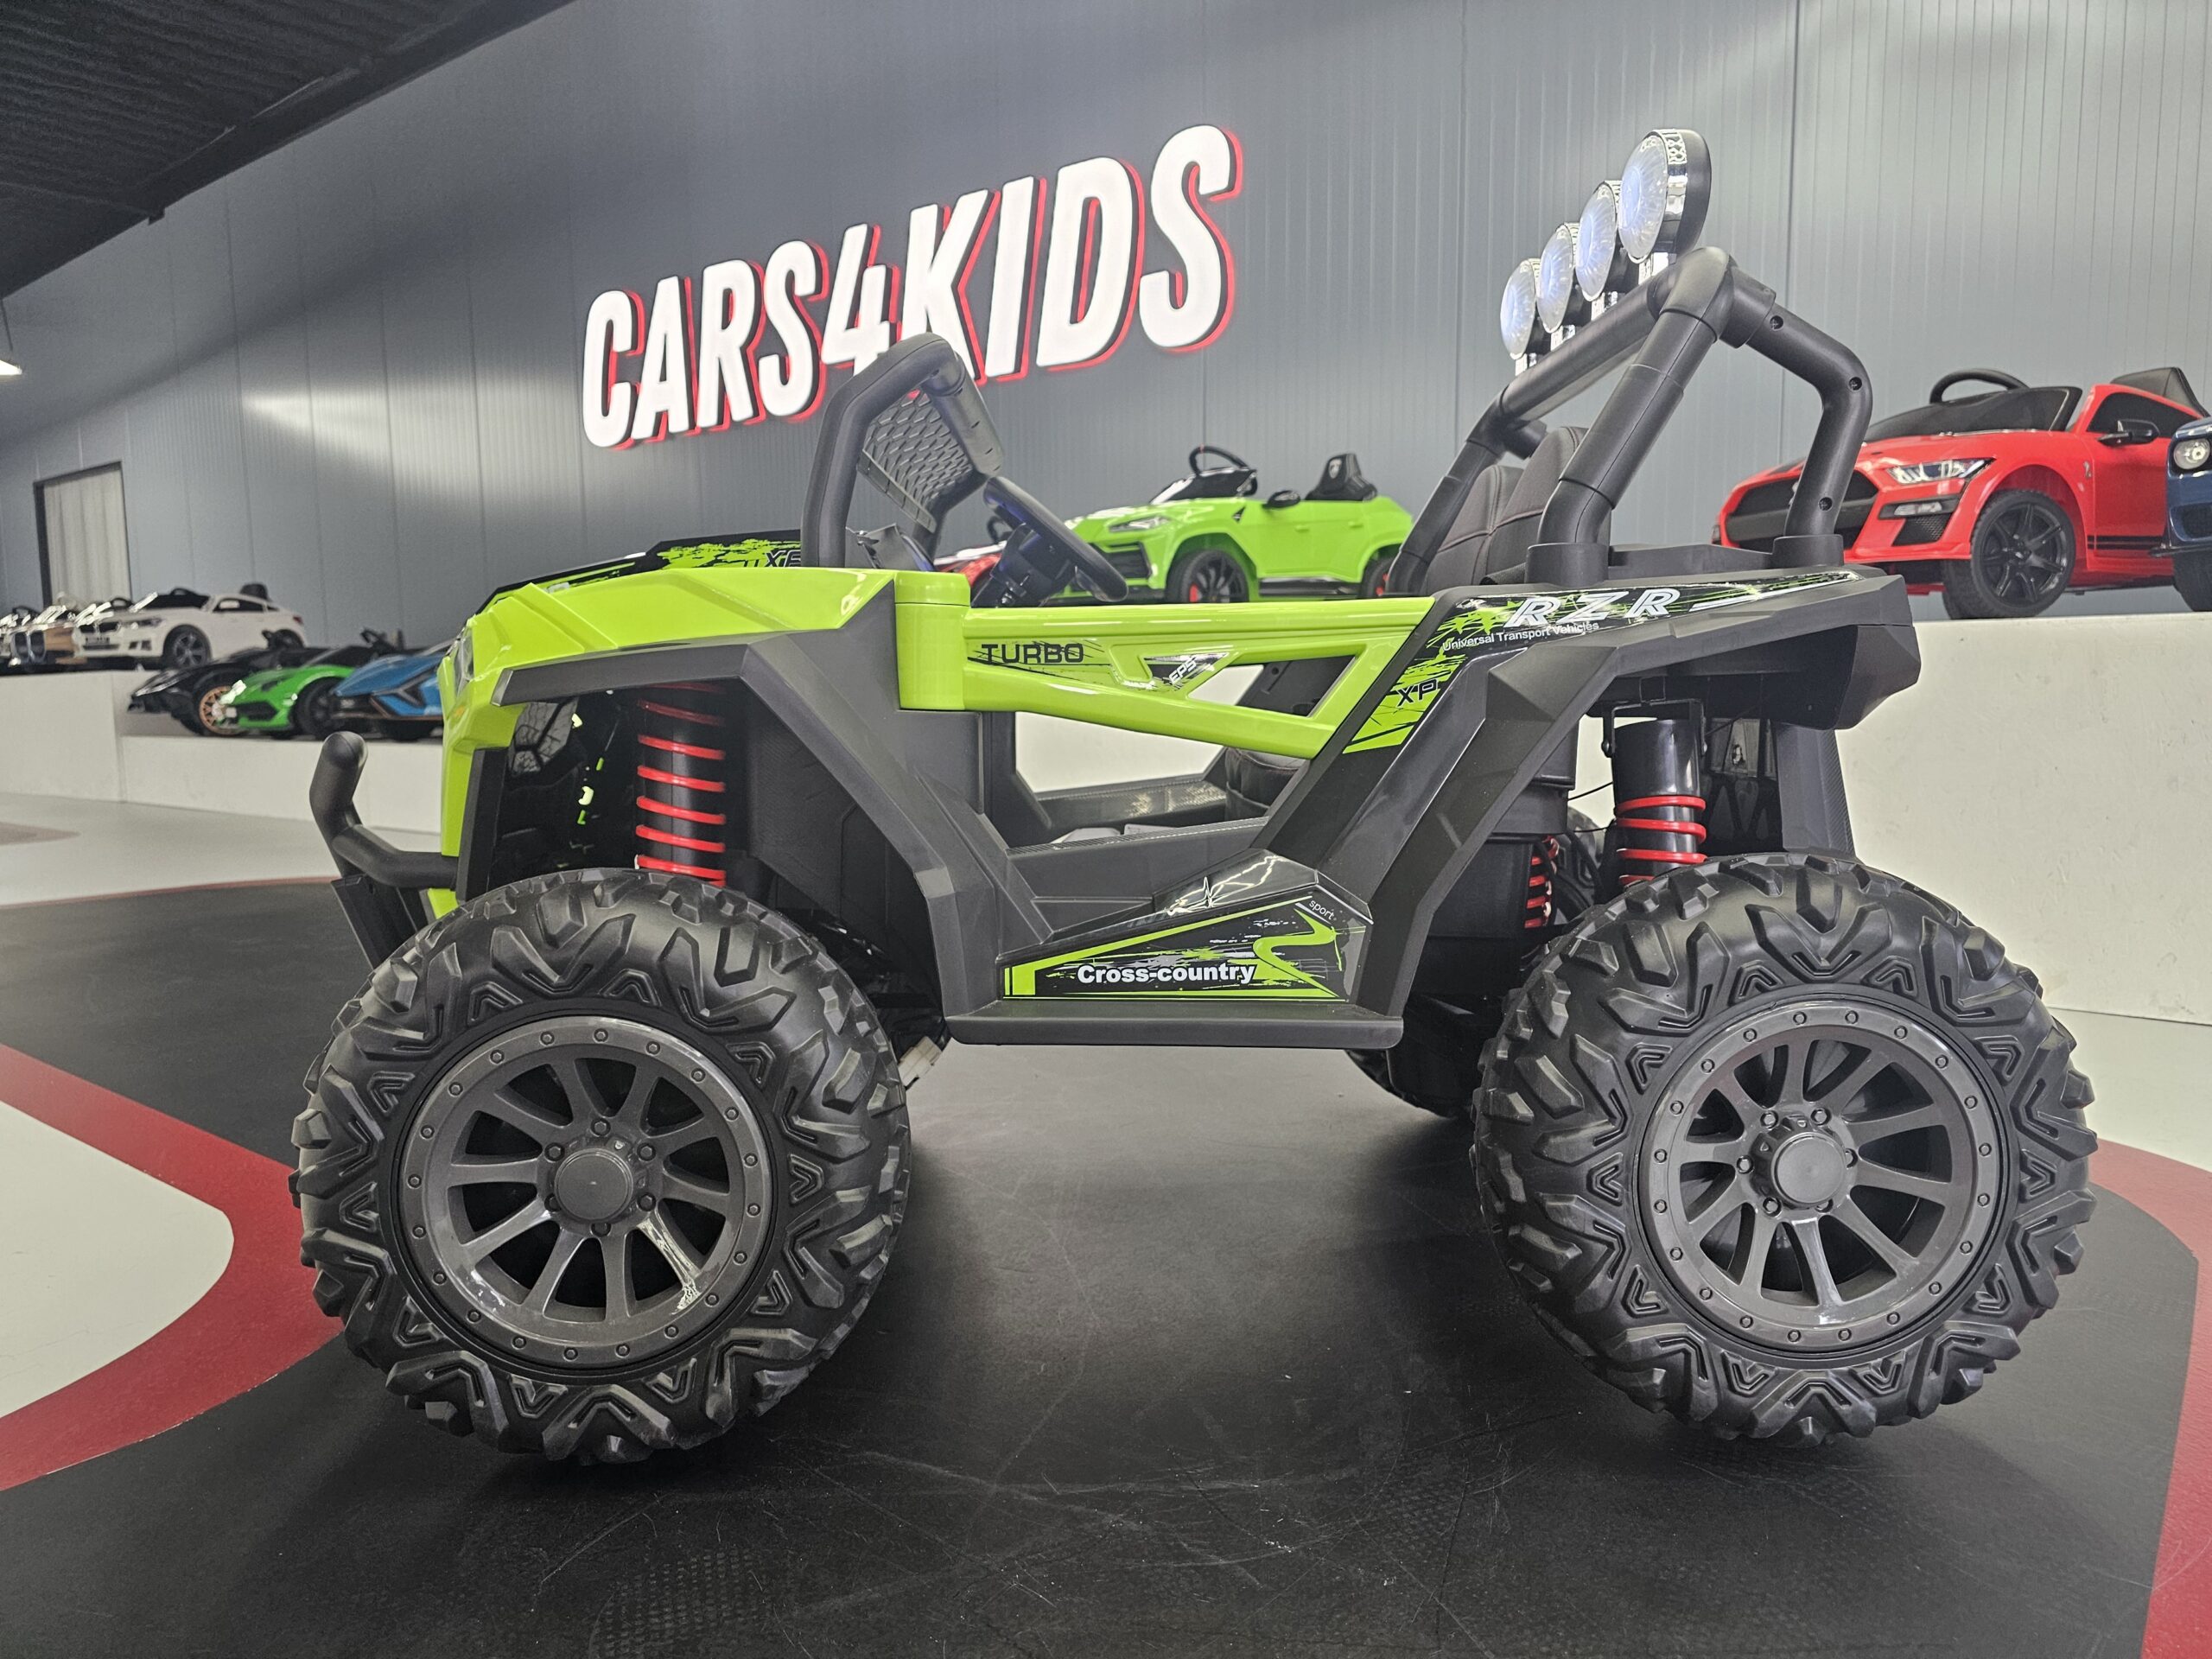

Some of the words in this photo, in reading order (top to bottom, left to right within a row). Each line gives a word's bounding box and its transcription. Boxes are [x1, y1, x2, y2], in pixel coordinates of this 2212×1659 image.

[582, 124, 1242, 449] CARS4KIDS
[1504, 588, 1681, 628] RZR
[1442, 632, 1495, 652] Universal
[1496, 626, 1551, 642] Transport
[1553, 621, 1599, 635] Vehicles
[981, 643, 1084, 664] TURBO
[1168, 658, 1197, 684] EPS
[1396, 678, 1438, 707] XP
[1308, 899, 1334, 920] sport
[1077, 963, 1255, 984] Cross-country
